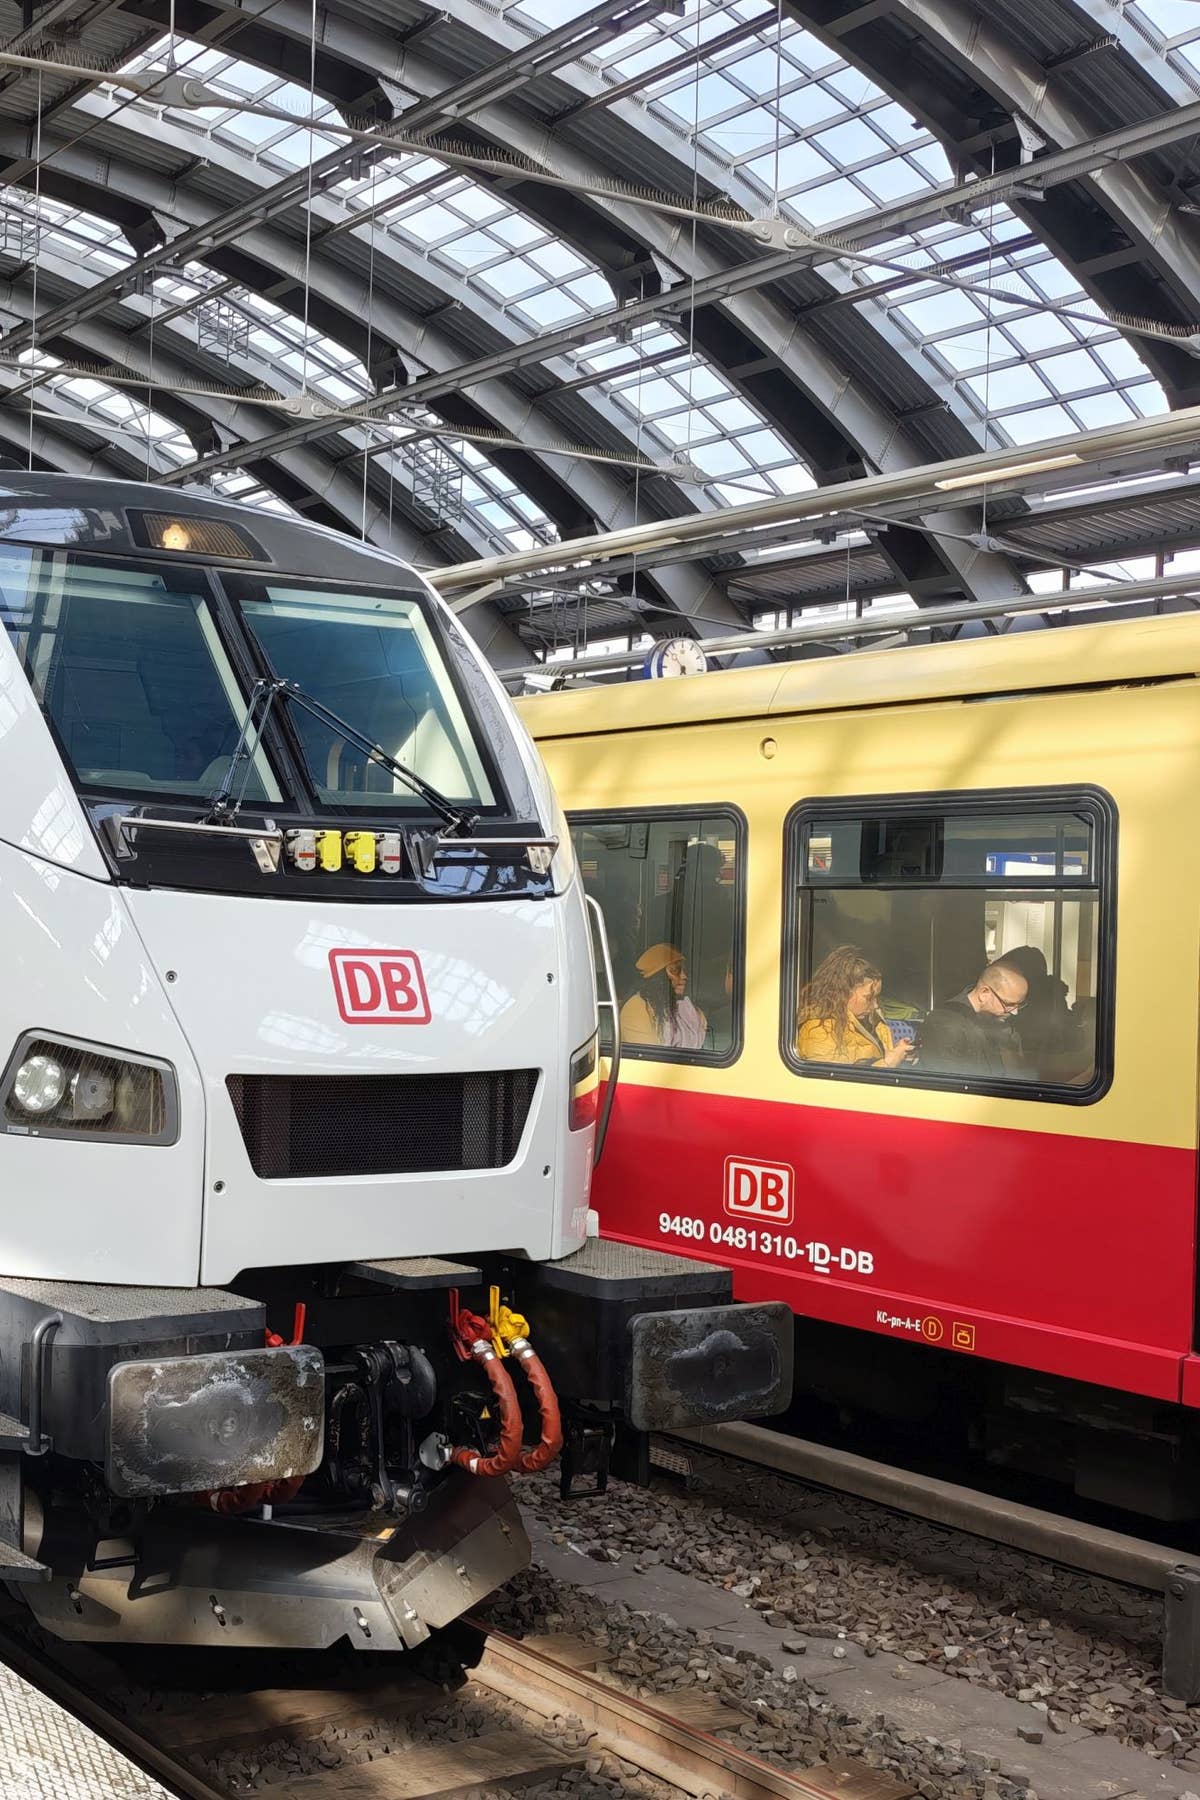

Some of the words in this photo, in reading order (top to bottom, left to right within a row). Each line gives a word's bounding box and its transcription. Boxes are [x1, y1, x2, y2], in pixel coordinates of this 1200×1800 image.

[340, 959, 420, 1013] DB
[731, 1165, 786, 1214] DB
[658, 1212, 705, 1241] 9480
